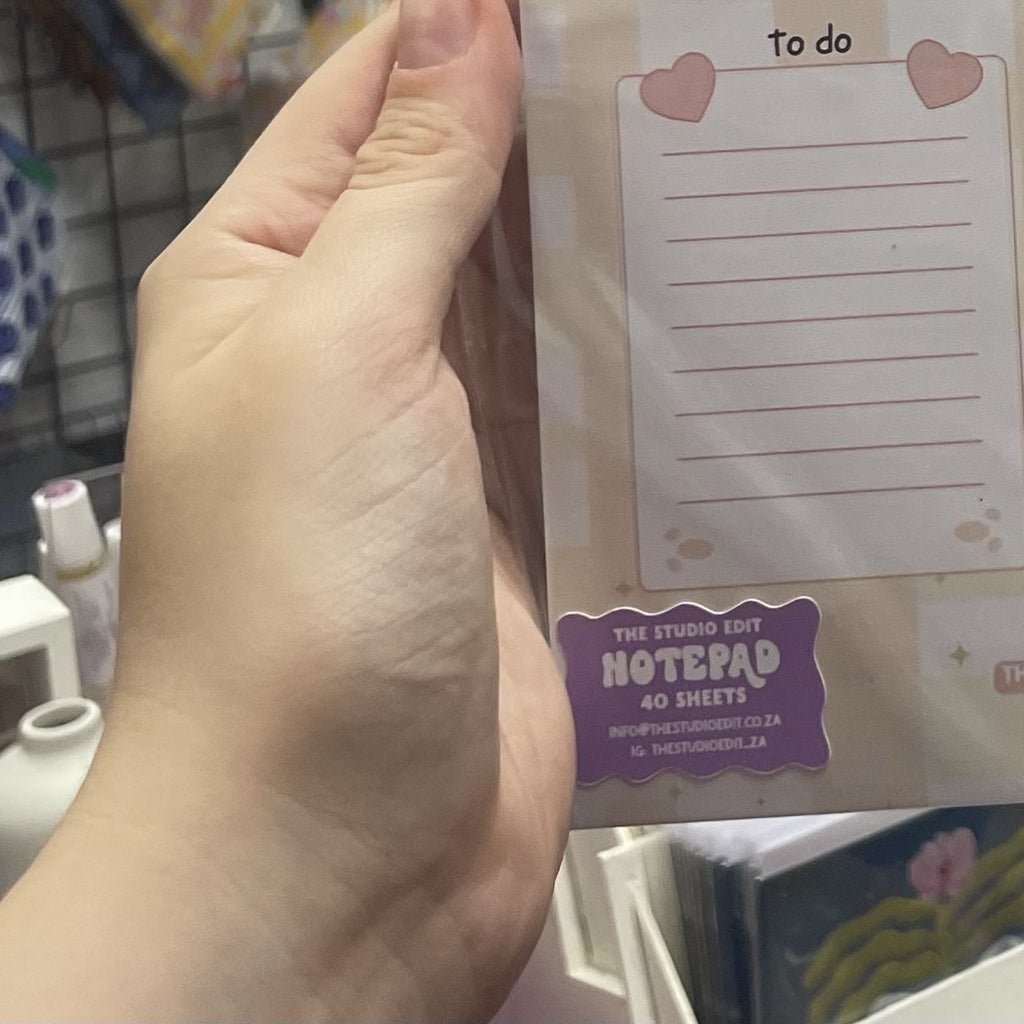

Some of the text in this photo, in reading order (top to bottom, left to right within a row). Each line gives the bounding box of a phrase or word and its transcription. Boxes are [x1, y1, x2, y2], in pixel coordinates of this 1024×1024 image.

[815, 22, 852, 55] do
[613, 617, 762, 643] THE STUDIO EDIT
[602, 638, 781, 689] NOTEPAD
[640, 686, 747, 711] 40 SHEETS
